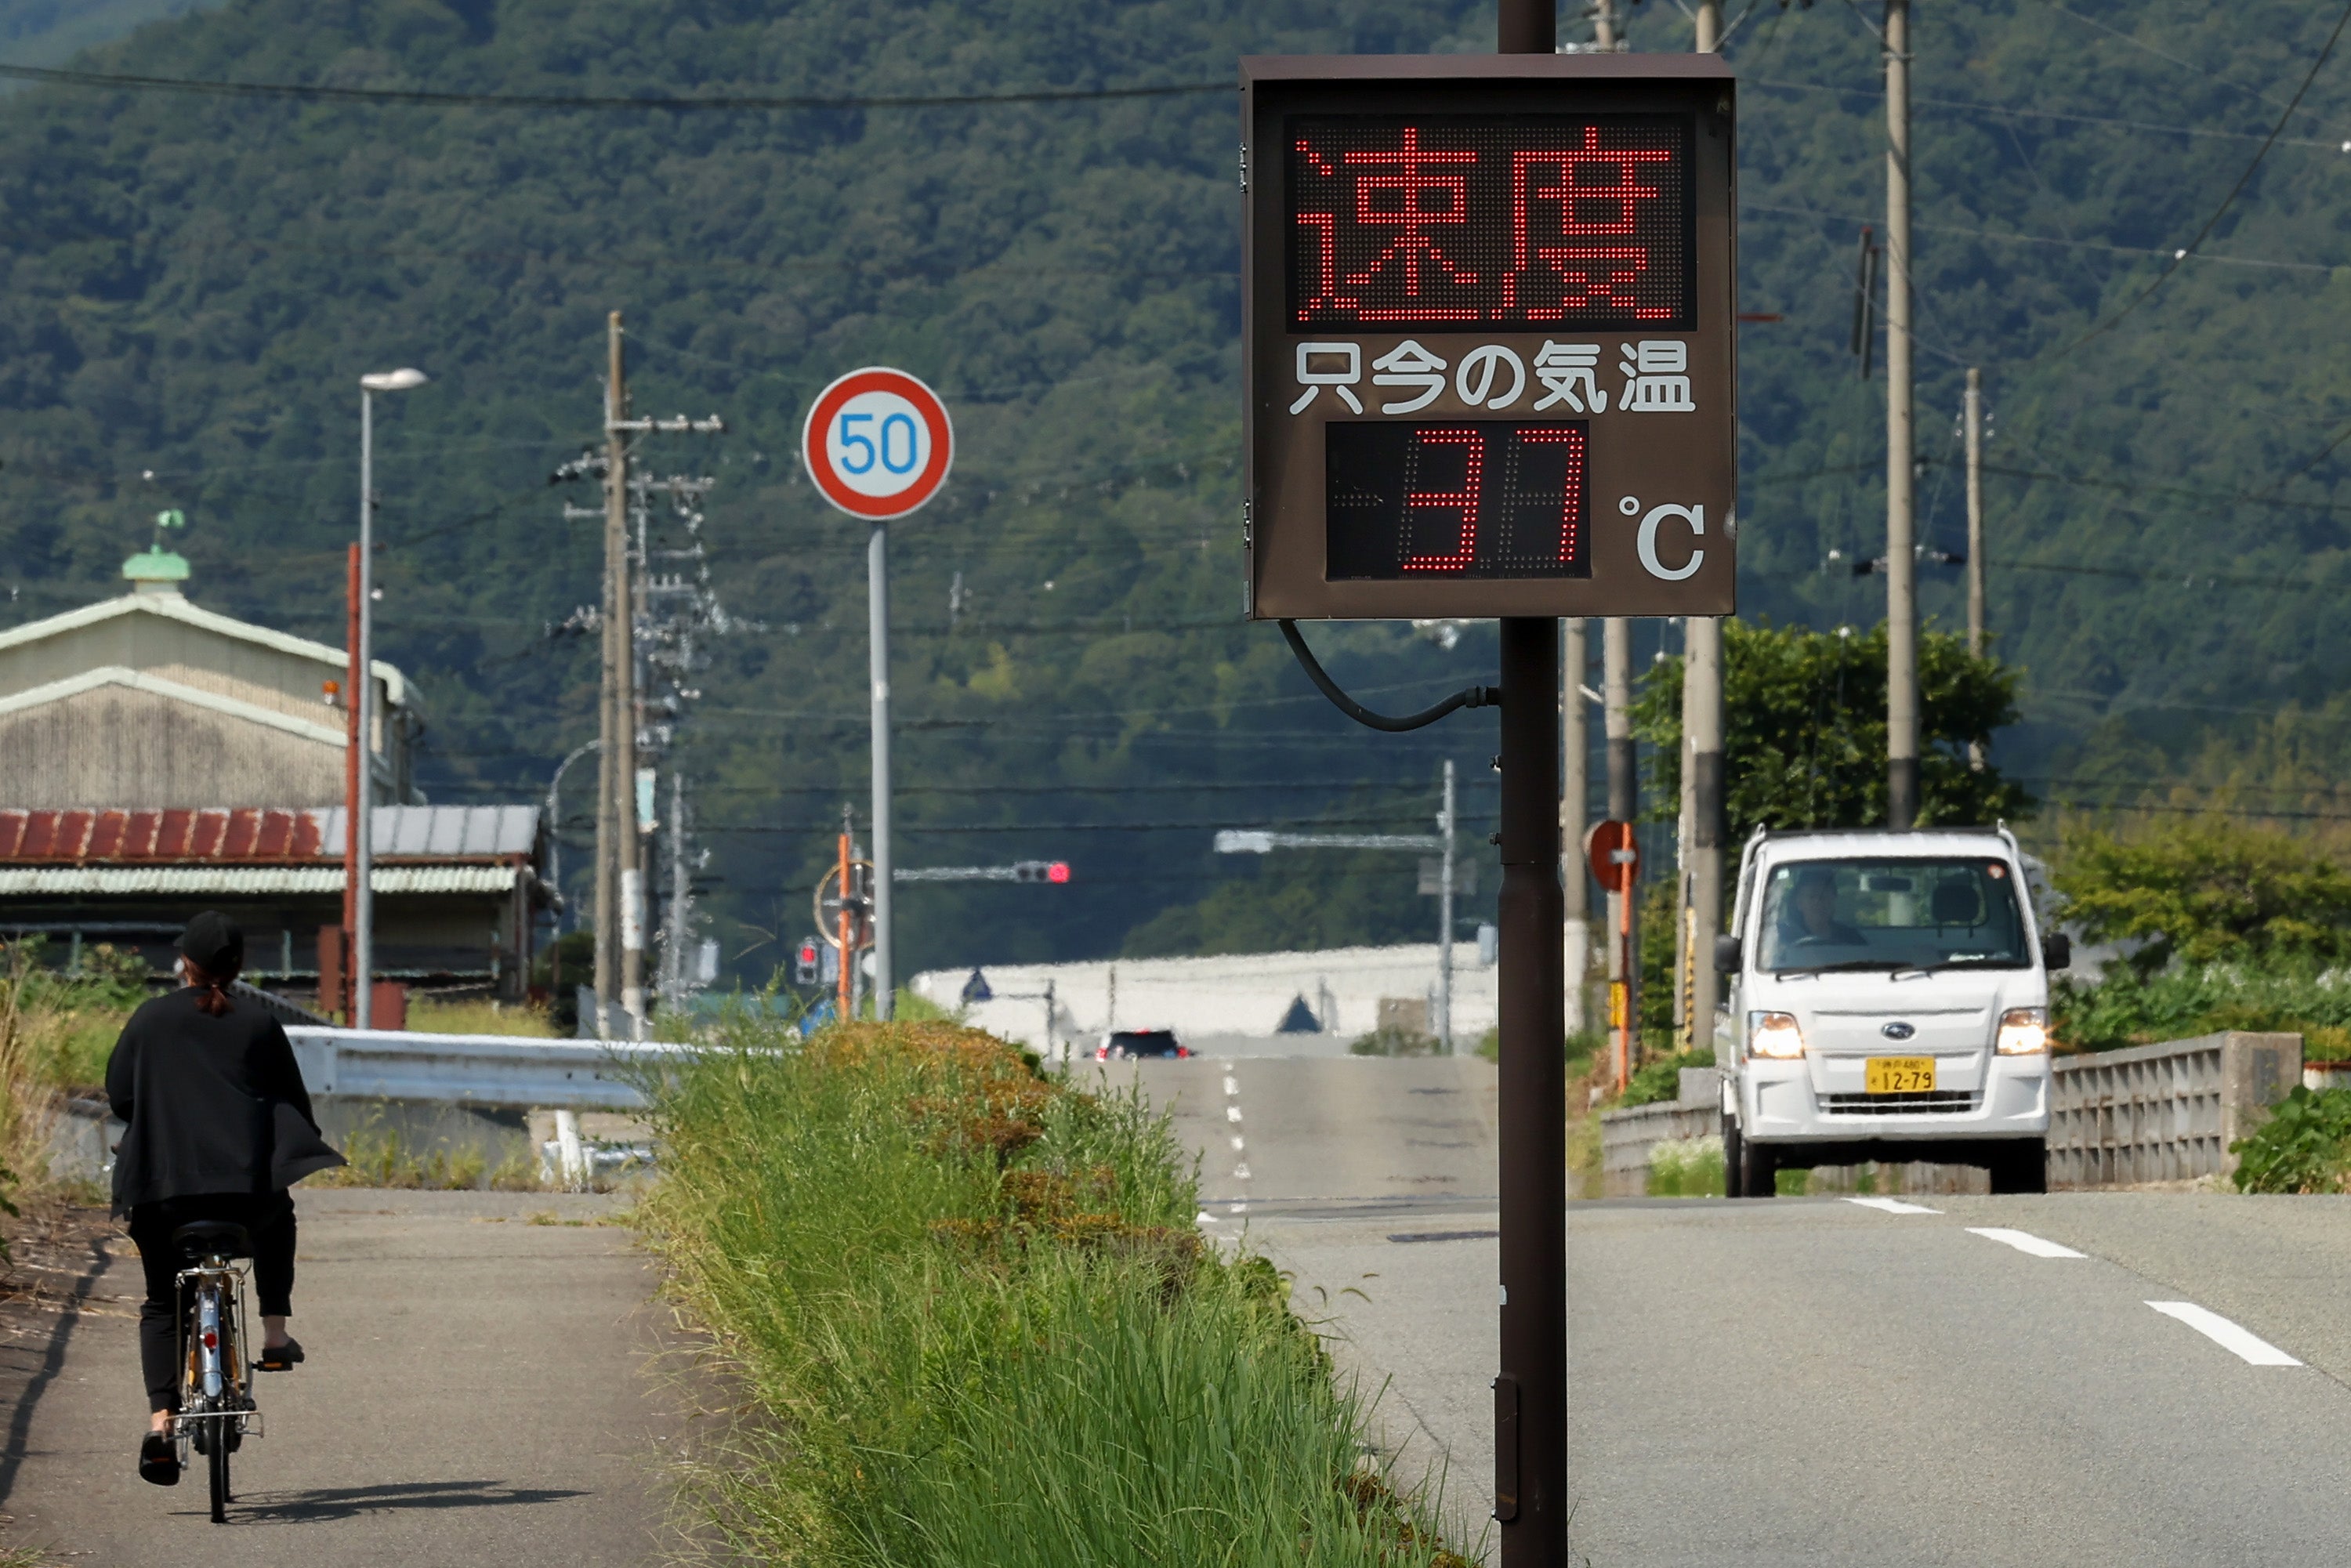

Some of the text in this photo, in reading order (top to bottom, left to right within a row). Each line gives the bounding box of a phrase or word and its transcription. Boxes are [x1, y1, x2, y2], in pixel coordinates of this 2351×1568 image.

[1295, 126, 1671, 321] 速度
[1289, 340, 1697, 415] 只今の気温
[840, 412, 918, 475] 50
[1403, 429, 1586, 570] 37
[1883, 1070, 1932, 1091] 12-79
